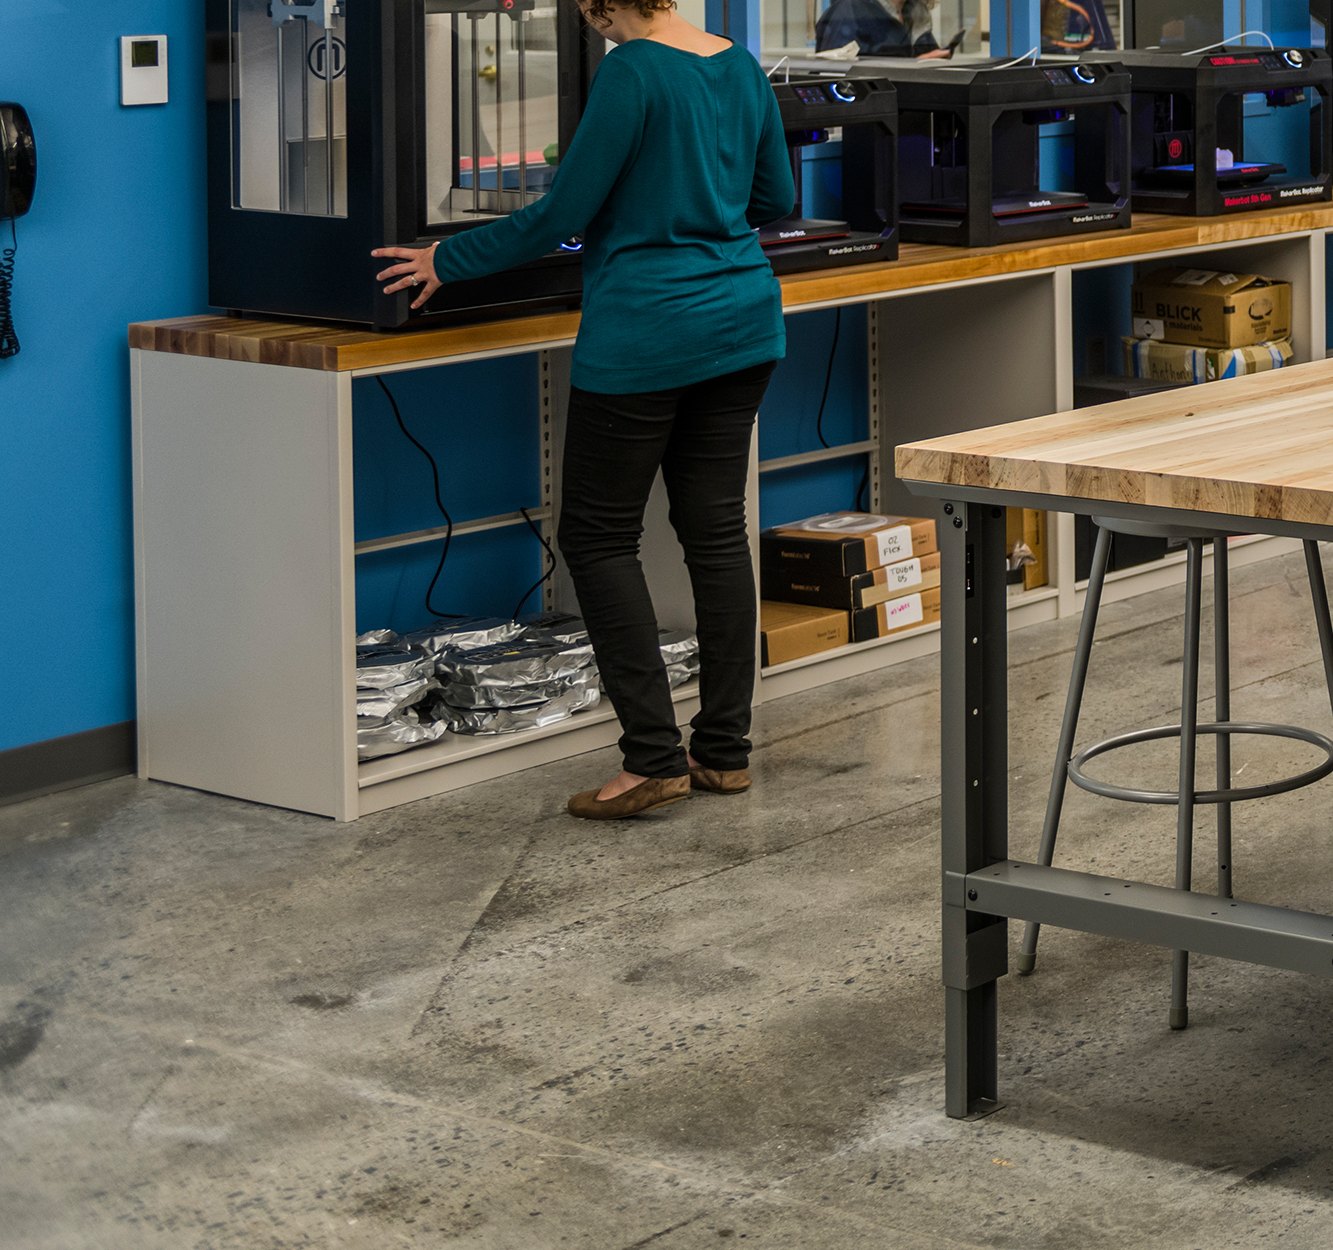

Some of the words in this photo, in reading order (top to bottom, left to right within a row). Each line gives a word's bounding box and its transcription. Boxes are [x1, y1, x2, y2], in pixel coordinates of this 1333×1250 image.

[1156, 303, 1203, 322] BLICK
[1169, 320, 1203, 332] materials
[890, 564, 914, 574] TOUGH
